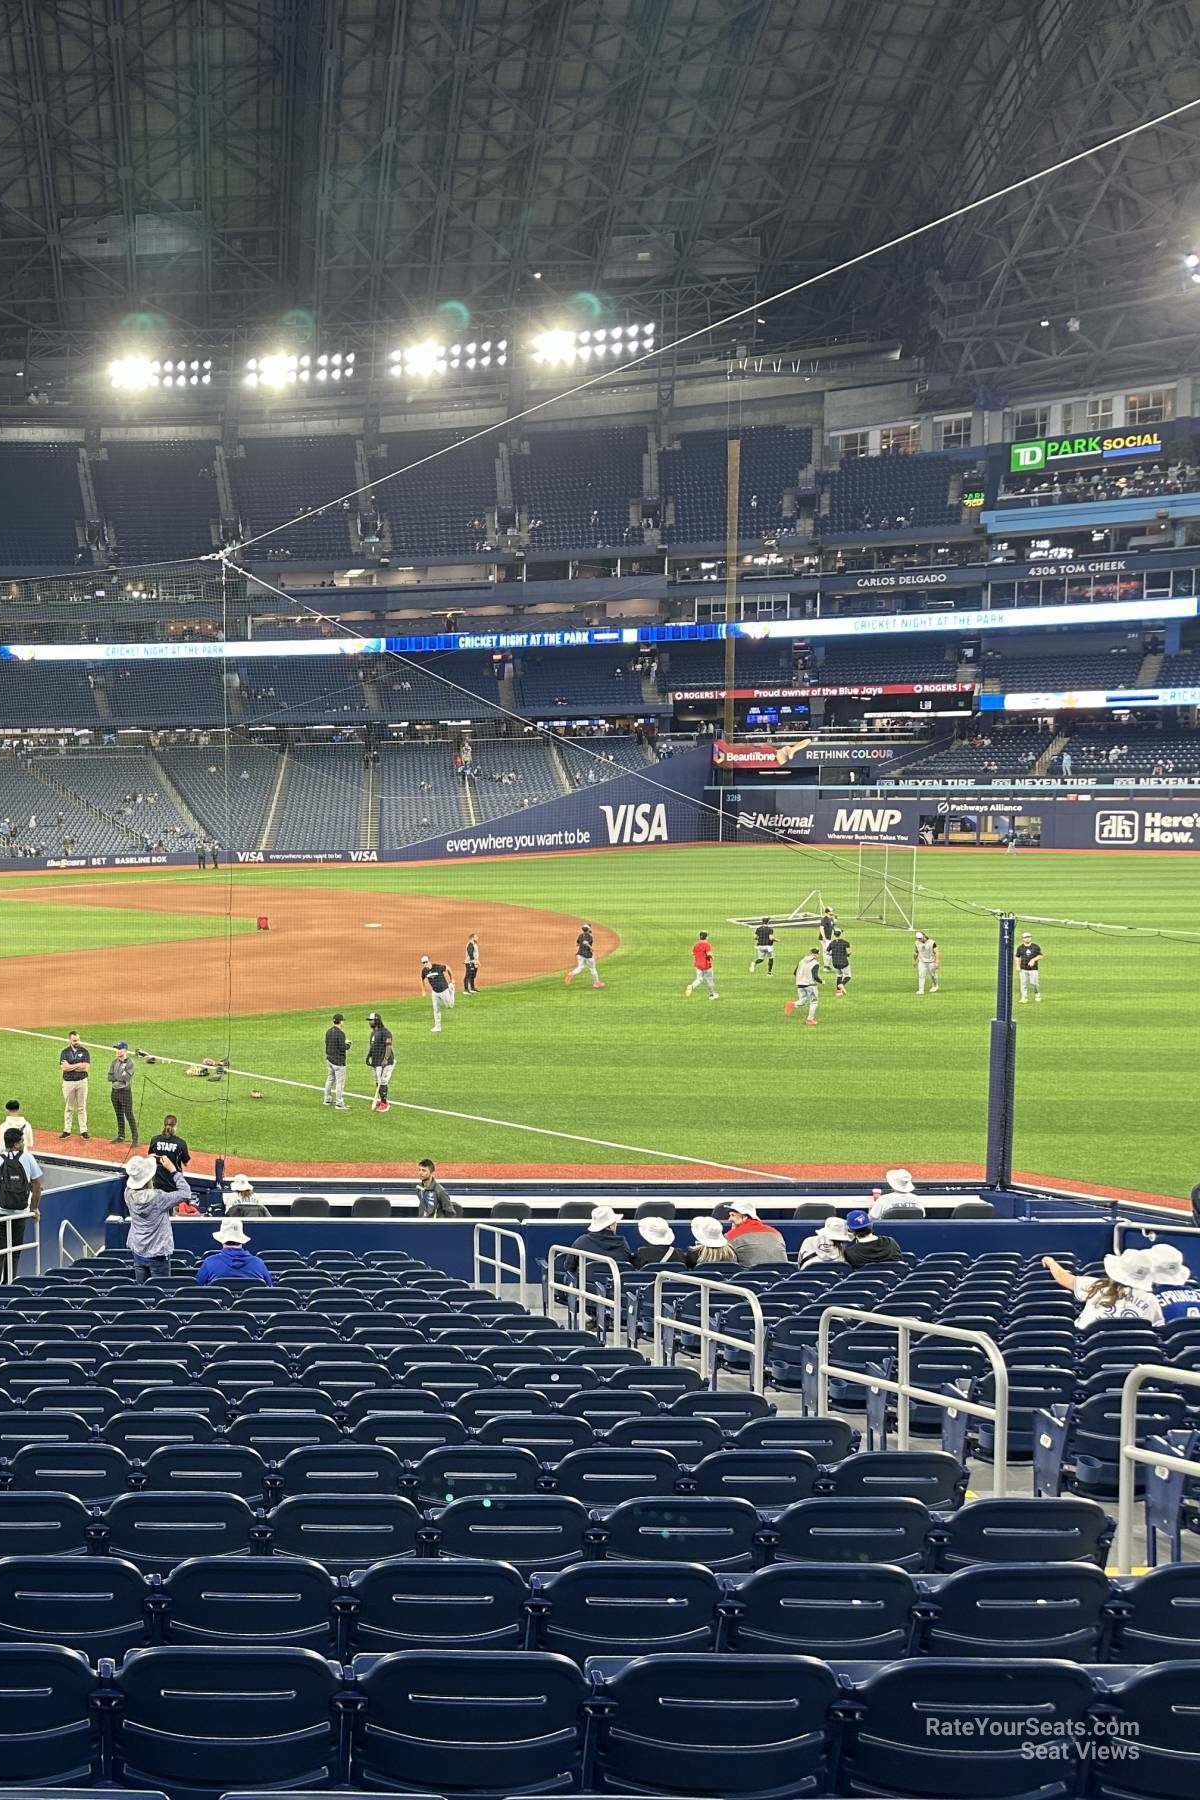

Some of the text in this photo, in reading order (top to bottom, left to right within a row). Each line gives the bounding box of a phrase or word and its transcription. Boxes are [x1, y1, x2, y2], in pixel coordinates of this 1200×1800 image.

[1014, 433, 1162, 466] TD PARK SOCIAL
[1028, 561, 1127, 576] 4306 TOM CHEEK
[856, 573, 947, 587] CARLOS DELGADO
[854, 613, 1004, 631] CRICKET NIGHT AT THE PARK
[458, 635, 497, 648] CRICKET
[500, 634, 528, 647] NIGHT
[529, 633, 542, 646] AT
[544, 632, 561, 645] THE
[564, 631, 589, 644] PARK
[105, 645, 224, 657] CRICKET NIGHT AT THE PARK
[753, 689, 780, 698] Proud
[811, 688, 821, 696] of
[822, 687, 837, 695] the
[838, 686, 859, 695] Blue
[860, 686, 883, 696] Jays
[923, 684, 957, 692] ROGERS
[683, 691, 714, 699] ROGERS
[1162, 691, 1200, 702] CRICK
[726, 749, 894, 762] BeautiTone RETHINK COLOUR
[950, 803, 1023, 813] Pathways Alliance
[599, 803, 669, 844] VISA
[833, 809, 901, 832] MNP
[446, 829, 590, 854] everywhere you want to be
[1144, 828, 1195, 843] How.
[46, 857, 107, 868] theScore BET
[115, 856, 168, 865] BASELINE BOX
[235, 851, 265, 862] VISA
[348, 851, 378, 862] VISA
[156, 1141, 178, 1153] STAFF
